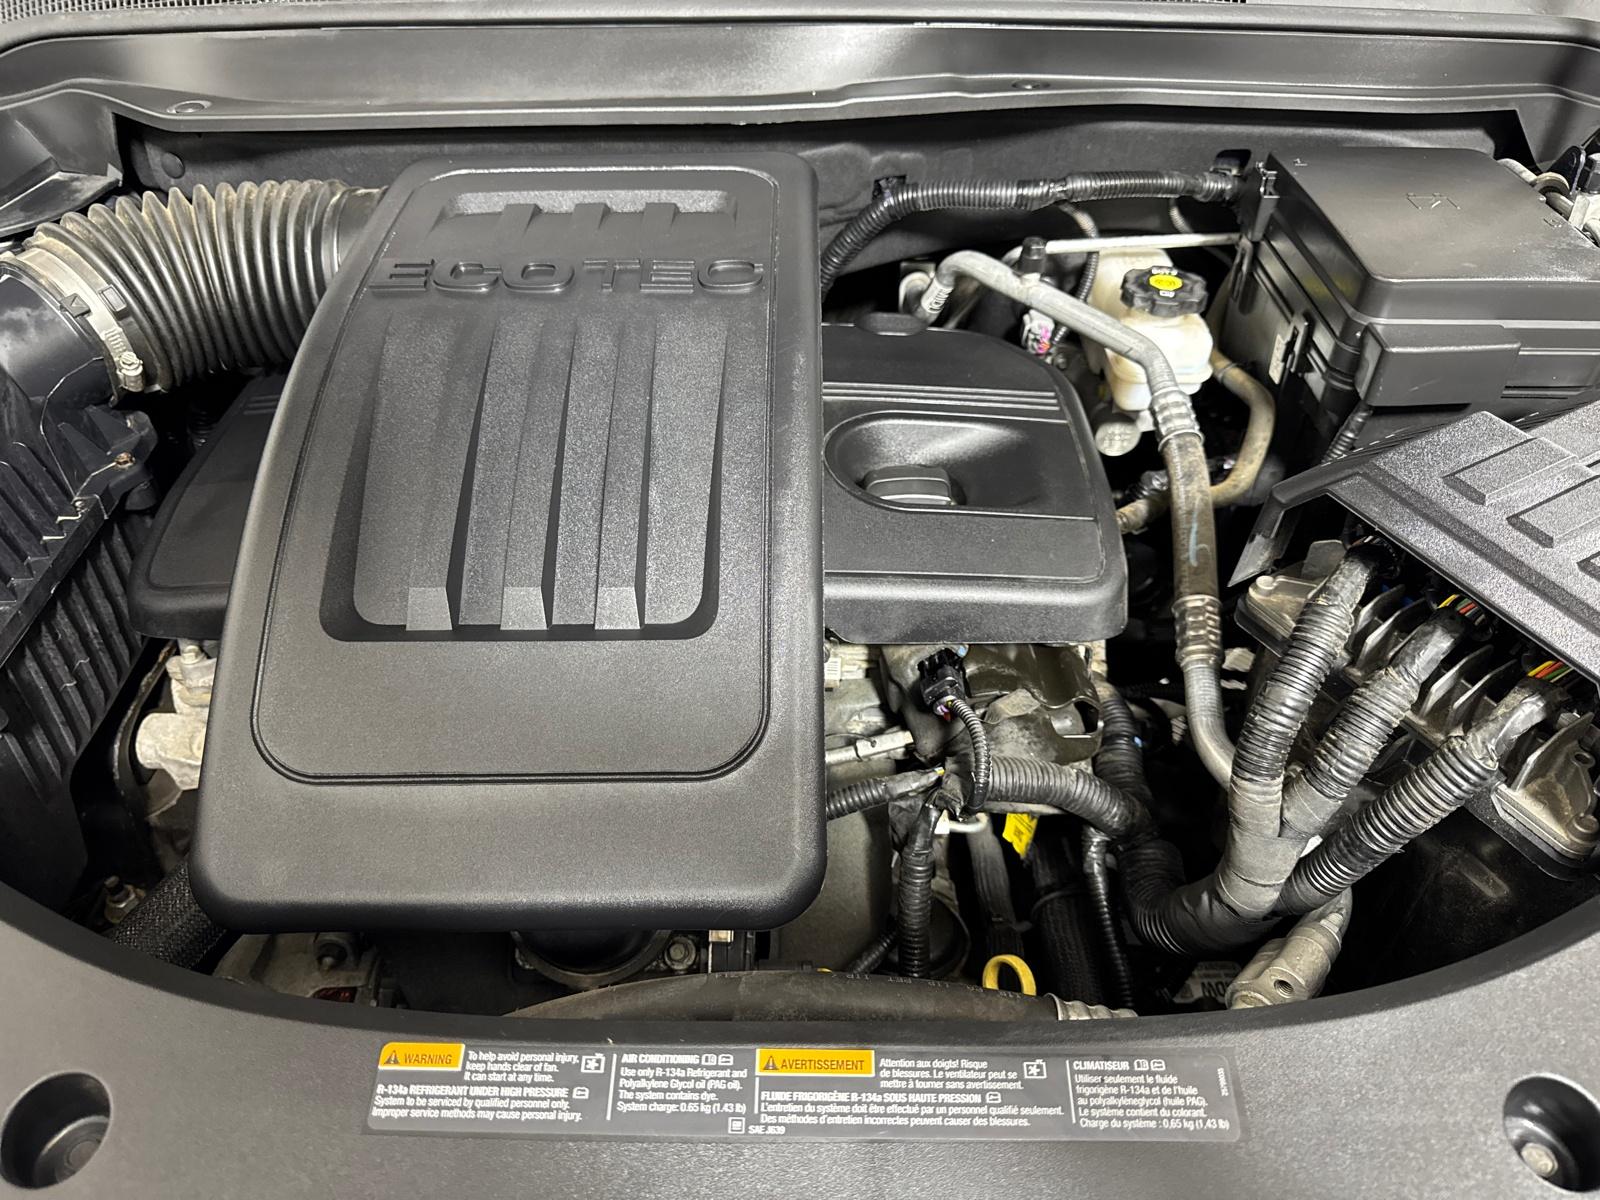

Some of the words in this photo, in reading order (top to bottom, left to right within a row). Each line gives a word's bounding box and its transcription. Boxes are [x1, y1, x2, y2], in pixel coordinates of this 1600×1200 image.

[369, 258, 765, 297] ECOTEC
[404, 1053, 452, 1065] WARNING
[468, 1051, 476, 1060] To
[478, 1051, 495, 1062] help
[498, 1052, 519, 1061] avoid
[520, 1053, 554, 1064] personal
[621, 1054, 637, 1063] AIR
[639, 1054, 699, 1064] CONDITIONING
[466, 1062, 485, 1072] keep
[487, 1063, 511, 1072] hands
[513, 1063, 532, 1072] clear
[534, 1064, 542, 1072] of
[543, 1064, 559, 1072] fan.
[781, 1059, 864, 1070] AVERTISSEMENT
[880, 1059, 914, 1067] Attention
[932, 1060, 959, 1070] doigts!
[961, 1060, 988, 1070] Risque
[1073, 1061, 1129, 1070] CLIMATISEUR
[464, 1072, 472, 1080] It
[488, 1073, 506, 1081] start
[517, 1075, 532, 1084] any
[533, 1074, 554, 1082] time.
[620, 1067, 636, 1076] Use
[638, 1068, 654, 1078] only
[656, 1068, 685, 1077] R-134a
[687, 1068, 730, 1079] Refrigerant
[731, 1069, 747, 1077] and
[880, 1069, 891, 1077] de
[892, 1070, 931, 1078] blessures.
[933, 1070, 944, 1078] Le
[945, 1070, 987, 1079] ventilateur
[988, 1071, 1006, 1081] peut
[619, 1079, 668, 1089] Polyalkylene
[670, 1080, 694, 1089] Glycol
[696, 1080, 706, 1088] oil
[707, 1080, 726, 1090] (PAG
[727, 1080, 743, 1091] oil).
[880, 1079, 907, 1088] mettre
[908, 1079, 914, 1088] à
[915, 1080, 944, 1089] tourner
[966, 1081, 1024, 1089] avertissement.
[1075, 1075, 1102, 1083] Utiliser
[1104, 1075, 1145, 1083] seulement
[1146, 1075, 1153, 1083] le
[1155, 1075, 1178, 1084] fluide
[377, 1084, 408, 1095] R-134a
[410, 1085, 468, 1096] REFRIGERANT
[469, 1086, 499, 1096] UNDER
[501, 1087, 521, 1096] HIGH
[523, 1087, 568, 1097] PRESSURE
[619, 1090, 634, 1099] The
[635, 1092, 664, 1101] system
[666, 1091, 699, 1100] contains
[700, 1092, 718, 1101] dye.
[1076, 1085, 1119, 1095] frigorigène
[1120, 1086, 1150, 1094] R-134a
[1161, 1086, 1171, 1095] de
[761, 1091, 792, 1100] FLUIDE
[851, 1092, 882, 1102] R-134a
[884, 1093, 907, 1102] SOUS
[909, 1093, 937, 1102] HAUTE
[939, 1093, 982, 1103] PRESSION
[1163, 1097, 1184, 1106] (huile
[1186, 1097, 1208, 1107] PAG).
[374, 1097, 406, 1107] System
[407, 1098, 415, 1106] to
[416, 1098, 427, 1106] be
[429, 1098, 461, 1106] serviced
[463, 1099, 474, 1109] by
[476, 1099, 509, 1109] qualified
[511, 1100, 549, 1110] personnel
[551, 1101, 570, 1110] only.
[617, 1102, 647, 1112] System
[680, 1103, 699, 1112] 0.65
[701, 1103, 711, 1113] kg
[713, 1103, 734, 1113] (1.43
[735, 1103, 746, 1114] lb)
[804, 1104, 815, 1112] du
[817, 1104, 850, 1114] système
[852, 1104, 867, 1113] doit
[869, 1103, 885, 1113] être
[887, 1103, 919, 1113] effectué
[921, 1107, 935, 1115] par
[949, 1105, 988, 1115] personnel
[989, 1105, 1018, 1116] qualifié
[1020, 1106, 1064, 1115] seulement.
[372, 1107, 409, 1119] Improper
[410, 1109, 439, 1118] service
[441, 1109, 475, 1119] methods
[477, 1111, 494, 1121] may
[522, 1110, 556, 1122] personal
[558, 1111, 582, 1122] injury.
[1079, 1108, 1089, 1116] Le
[1091, 1107, 1124, 1118] système
[1126, 1108, 1158, 1116] contient
[1160, 1108, 1170, 1117] du
[1172, 1108, 1207, 1117] colorant.
[760, 1114, 777, 1123] Des
[778, 1114, 818, 1124] méthodes
[864, 1115, 908, 1125] incorrectes
[910, 1118, 942, 1127] peuvent
[944, 1117, 971, 1126] causer
[973, 1117, 988, 1126] des
[989, 1117, 1031, 1126] blessures.
[1080, 1119, 1109, 1129] Charge
[1110, 1119, 1121, 1127] du
[1123, 1119, 1156, 1129] système
[1183, 1119, 1194, 1130] kg
[1218, 1119, 1229, 1130] lb)
[748, 1125, 766, 1134] SAE
